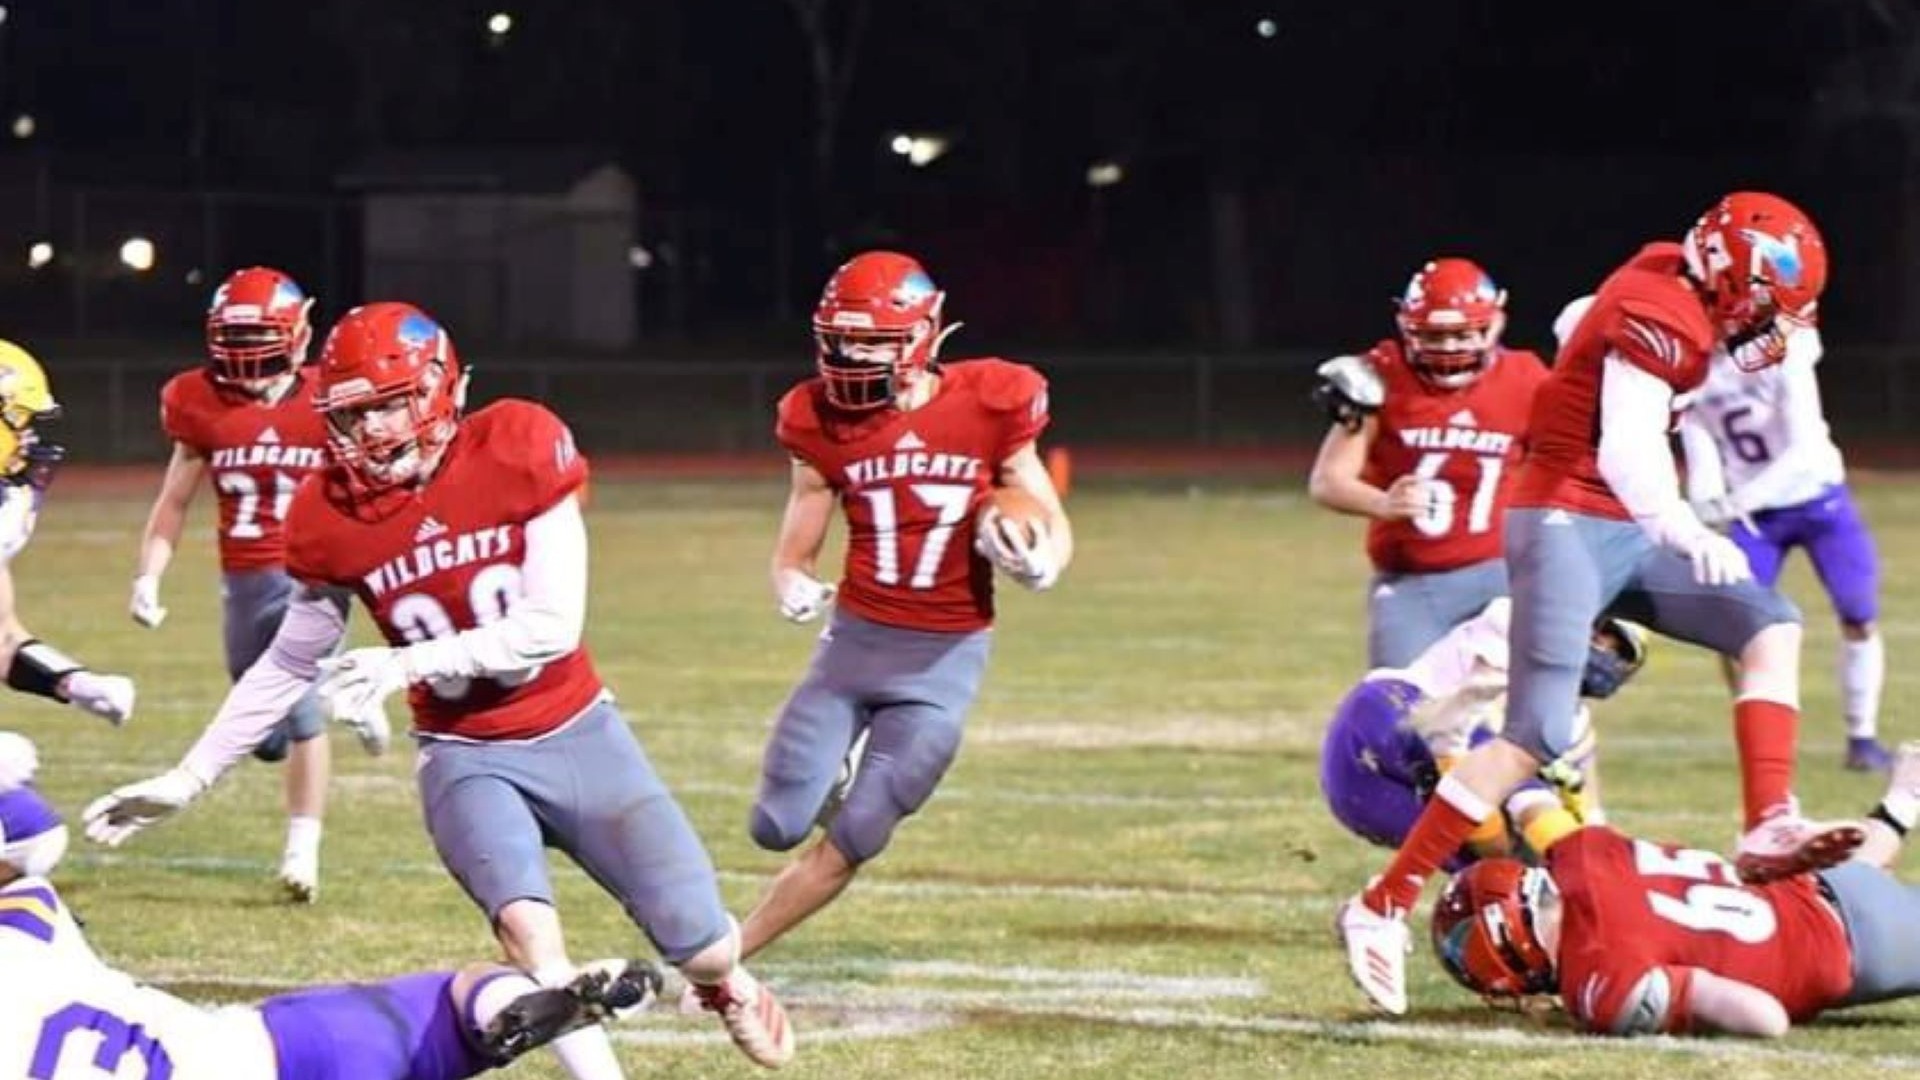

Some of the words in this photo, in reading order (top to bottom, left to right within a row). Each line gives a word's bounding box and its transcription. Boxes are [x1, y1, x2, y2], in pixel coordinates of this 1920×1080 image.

[1722, 406, 1770, 464] 6
[845, 453, 983, 484] WILDCATS
[363, 525, 513, 596] WILDCATS
[859, 484, 975, 587] 17
